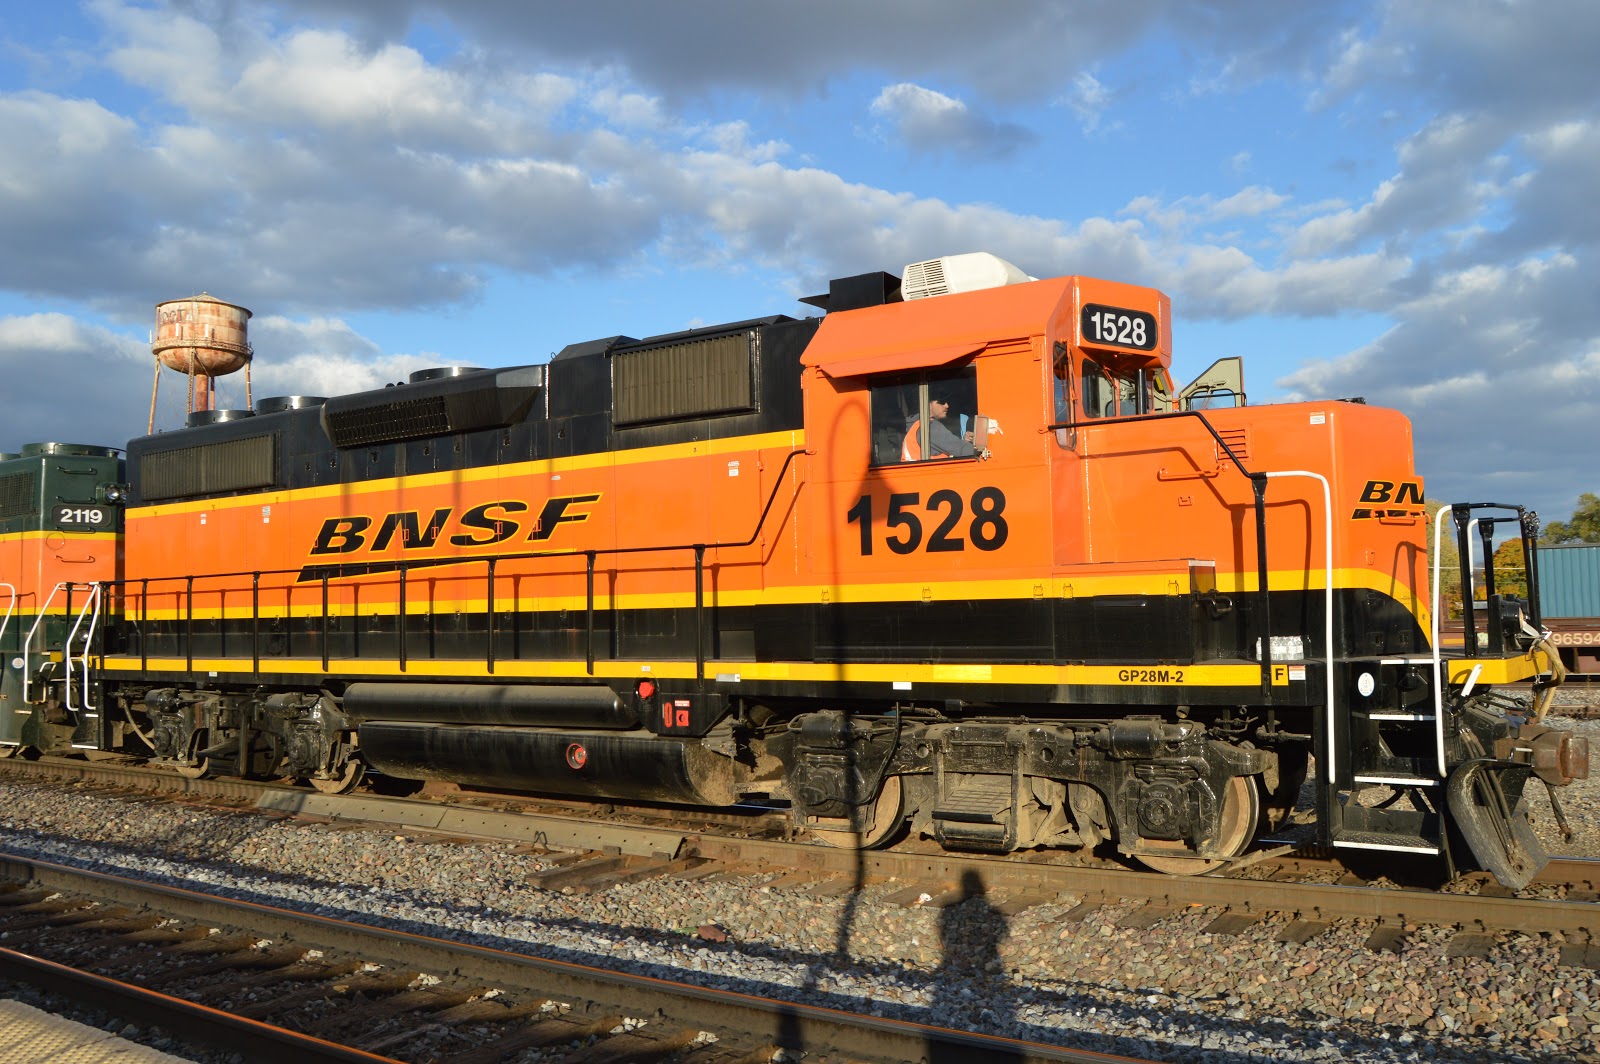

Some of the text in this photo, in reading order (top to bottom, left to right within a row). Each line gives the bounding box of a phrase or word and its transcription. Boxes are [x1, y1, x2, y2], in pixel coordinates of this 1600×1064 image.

[1090, 311, 1147, 346] 1528
[60, 508, 103, 524] 2119
[308, 492, 604, 557] BNSF
[847, 486, 1009, 556] 1528
[1118, 669, 1184, 683] GP28M-2
[1275, 668, 1285, 681] F
